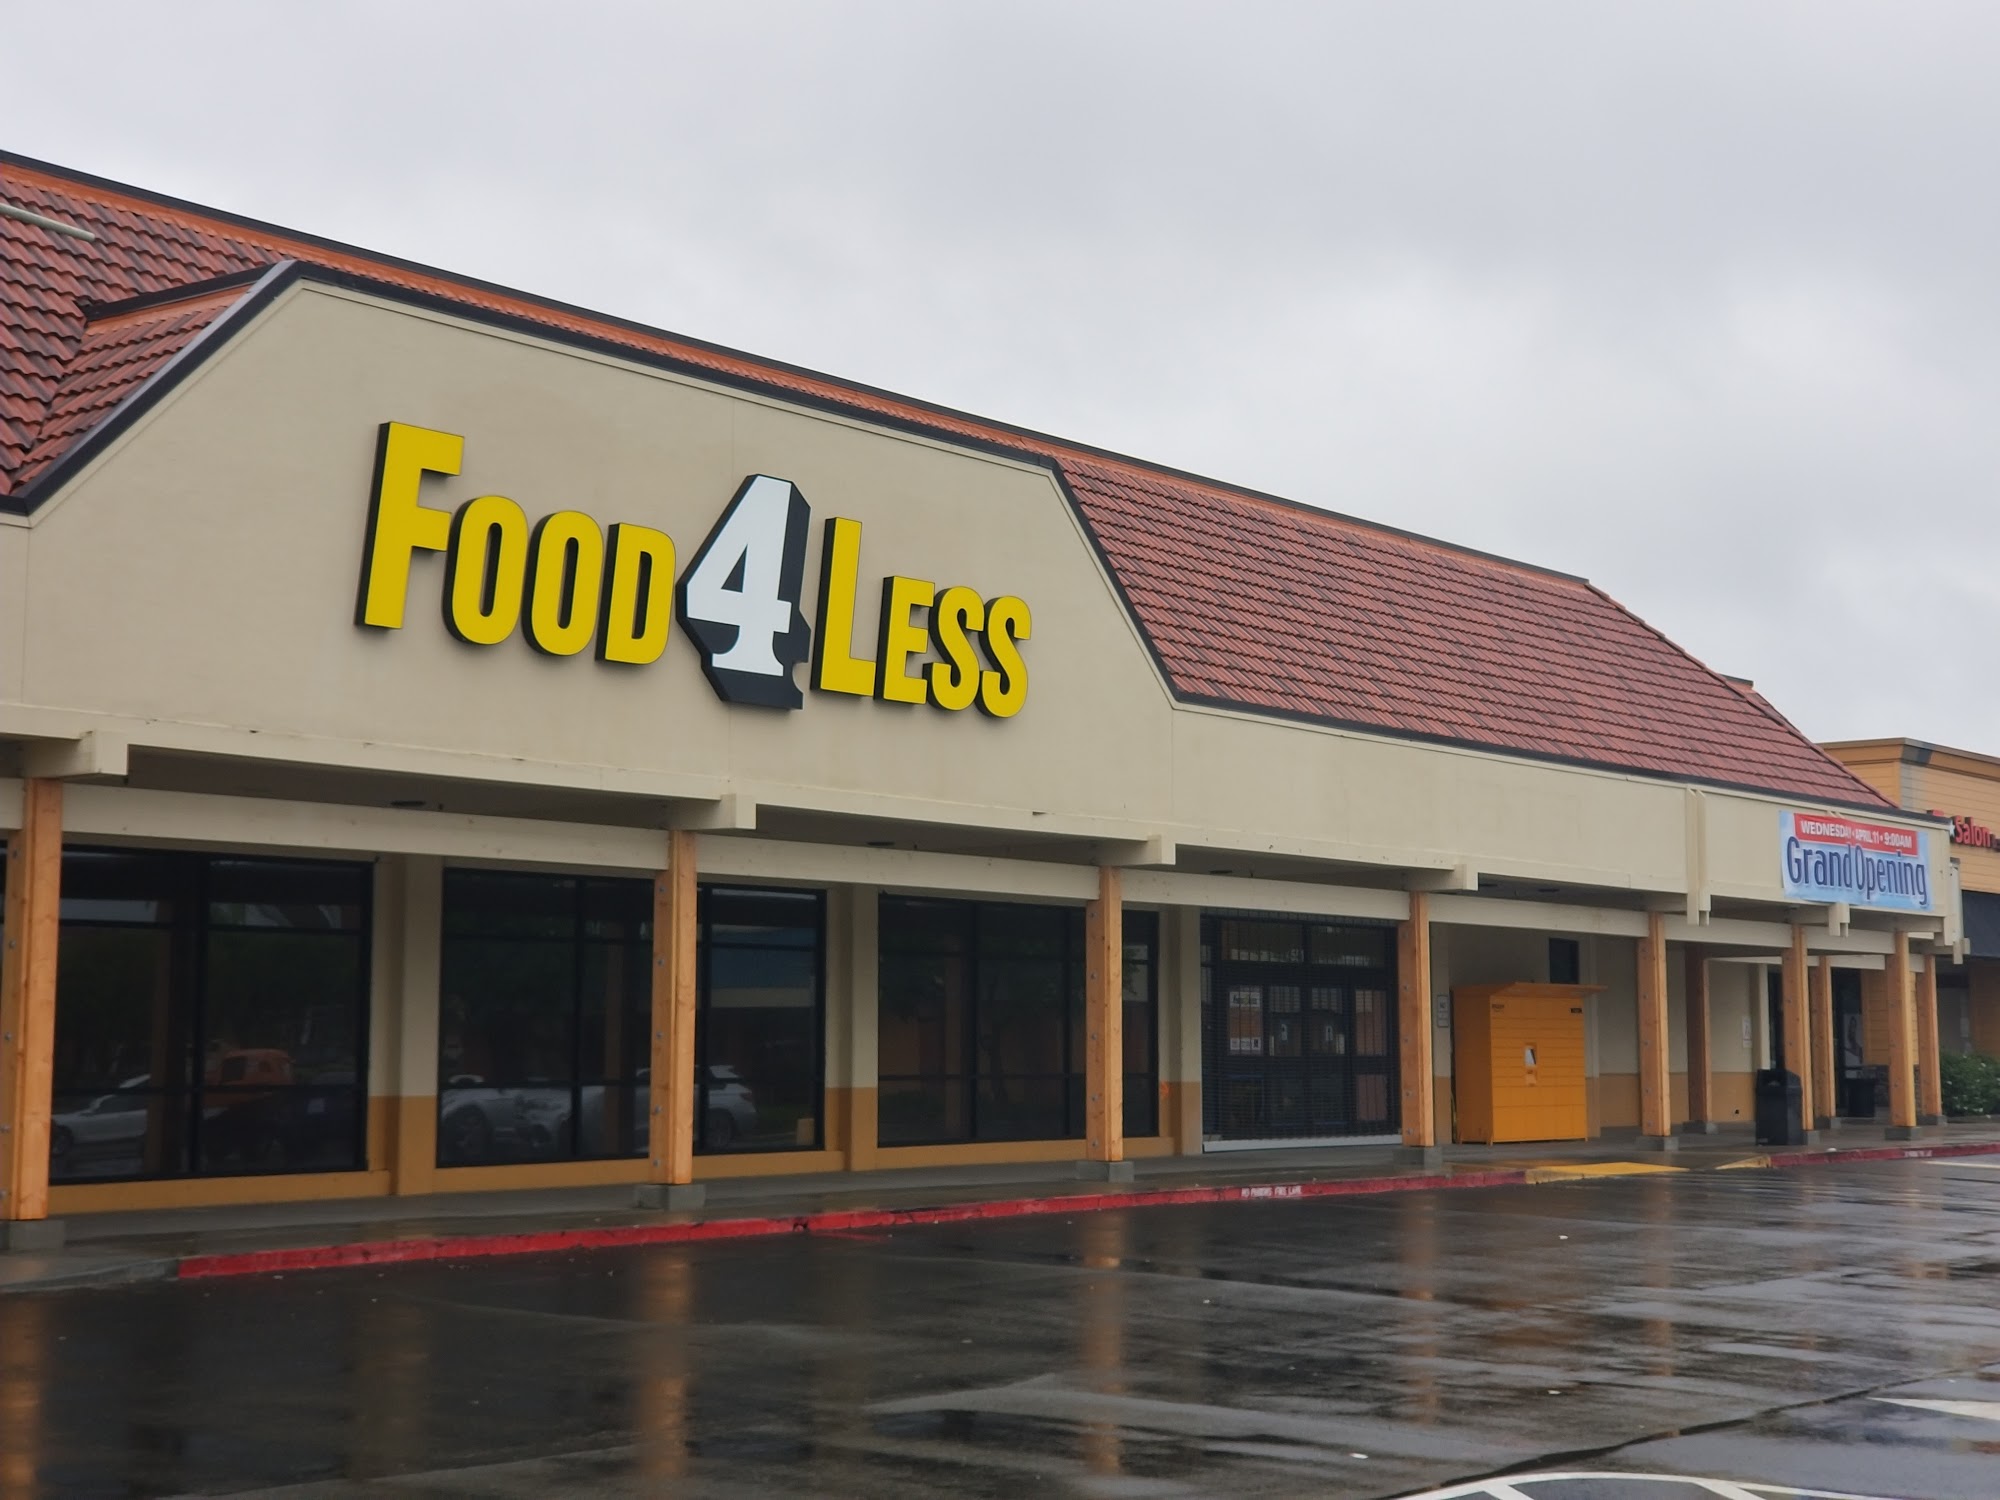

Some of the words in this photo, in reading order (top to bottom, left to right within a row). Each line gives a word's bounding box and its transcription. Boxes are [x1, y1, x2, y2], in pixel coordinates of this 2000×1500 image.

[685, 474, 795, 678] 4
[1801, 820, 1851, 839] WEDNESDAY
[1855, 828, 1873, 844] APRIL
[1954, 815, 1991, 848] Salon
[1787, 836, 1852, 888] Grand
[1855, 845, 1927, 906] Opening
